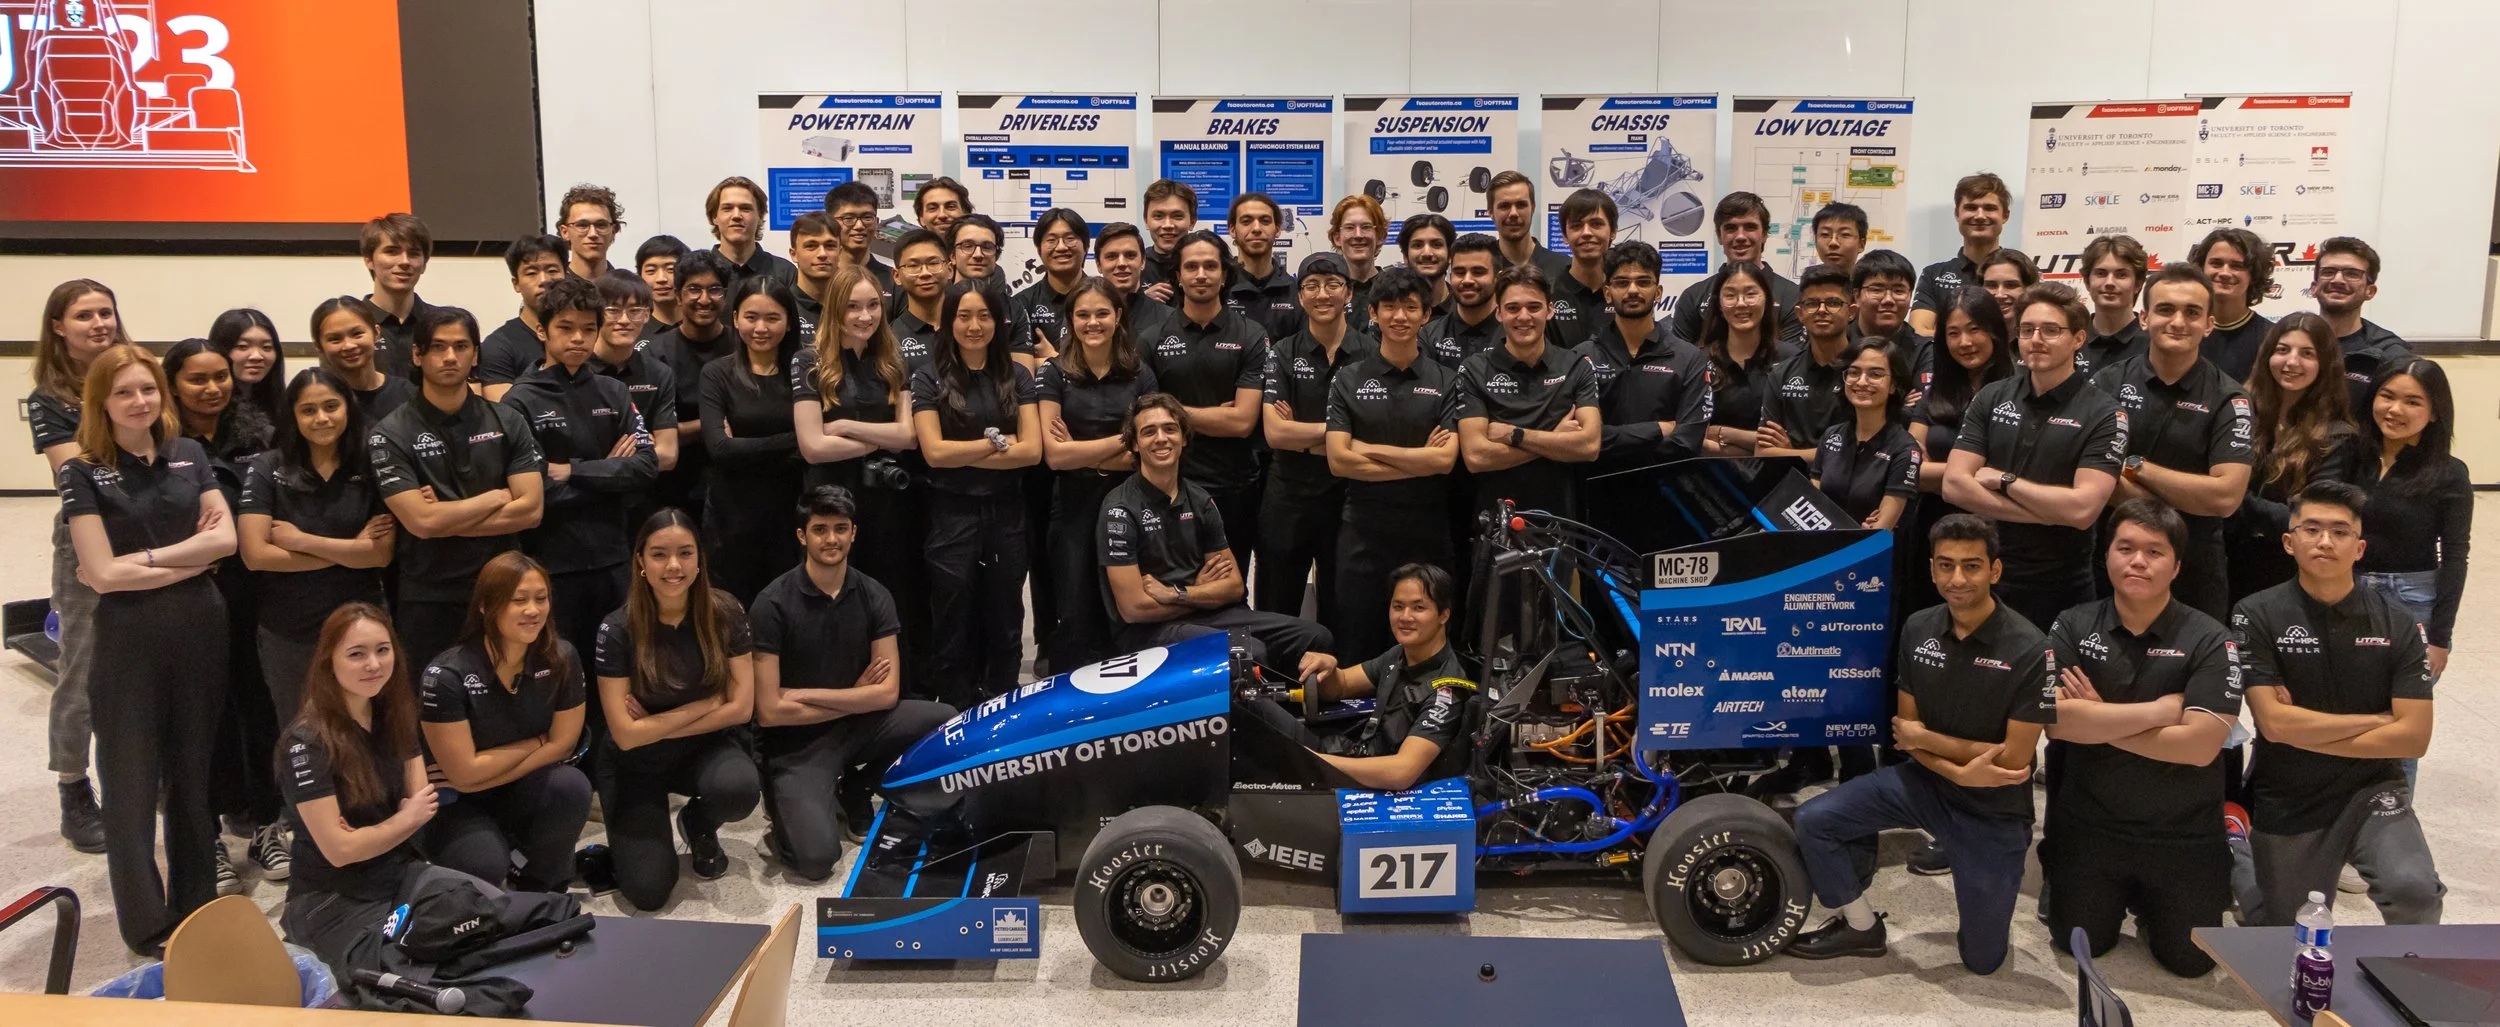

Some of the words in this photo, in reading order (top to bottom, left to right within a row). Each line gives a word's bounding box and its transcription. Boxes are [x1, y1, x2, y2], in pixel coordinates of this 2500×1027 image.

[788, 114, 915, 131] POWERTRAIN
[999, 114, 1101, 131] DRIVERLESS
[1207, 118, 1280, 135] BRAKES
[1374, 116, 1490, 133] SUSPENSION
[1591, 114, 1670, 131] CHASSIS
[1755, 118, 1803, 136] LOW
[1805, 119, 1892, 137] VOLTAGE
[1173, 143, 1200, 151] MANUAL
[1200, 143, 1229, 151] BRAKING
[2198, 185, 2220, 195] MC-78
[2041, 194, 2063, 204] MC-78
[2095, 226, 2128, 234] MAGNA
[1373, 386, 1388, 394] HPC
[1658, 556, 1709, 577] MC-78
[1658, 577, 1689, 585] MACHINE
[1690, 576, 1709, 584] SHOP
[1784, 593, 1836, 602] ENGINEERING
[1783, 602, 1814, 611] ALUMNI
[1815, 601, 1856, 610] NETWORK
[1657, 615, 1697, 623] STARS
[1720, 616, 1767, 632] TRAIL
[1820, 622, 1885, 632] aUToronto
[2277, 636, 2295, 645] ACT
[2300, 636, 2319, 645] HPC
[1655, 642, 1696, 658] NTN
[1790, 646, 1842, 656] Multimatic
[1914, 645, 1928, 655] ACT
[1929, 650, 1947, 661] HPC
[2277, 646, 2321, 654] TESLA
[1913, 654, 1945, 669] TESLA
[1731, 671, 1775, 681] MAGNA
[1828, 667, 1882, 679] KISSsoft
[1649, 682, 1705, 698] molex
[1781, 685, 1828, 698] atoms
[1712, 700, 1765, 713] AIRTECH
[1671, 722, 1692, 735] TE
[1853, 723, 1877, 731] ERA
[1825, 730, 1877, 738] GROUP
[940, 747, 1070, 794] UNIVERSITY
[1075, 739, 1107, 762] OF
[1111, 715, 1228, 756] TORONTO
[1232, 781, 1302, 790] Electro-Meters
[1268, 843, 1326, 871] IEEE
[1667, 831, 1731, 892] Hoosier
[1088, 841, 1163, 894] Hoosier
[1370, 851, 1449, 890] 217
[453, 917, 480, 935] NTN
[1742, 898, 1806, 960] Hoosier
[1148, 927, 1223, 977] Hoosier
